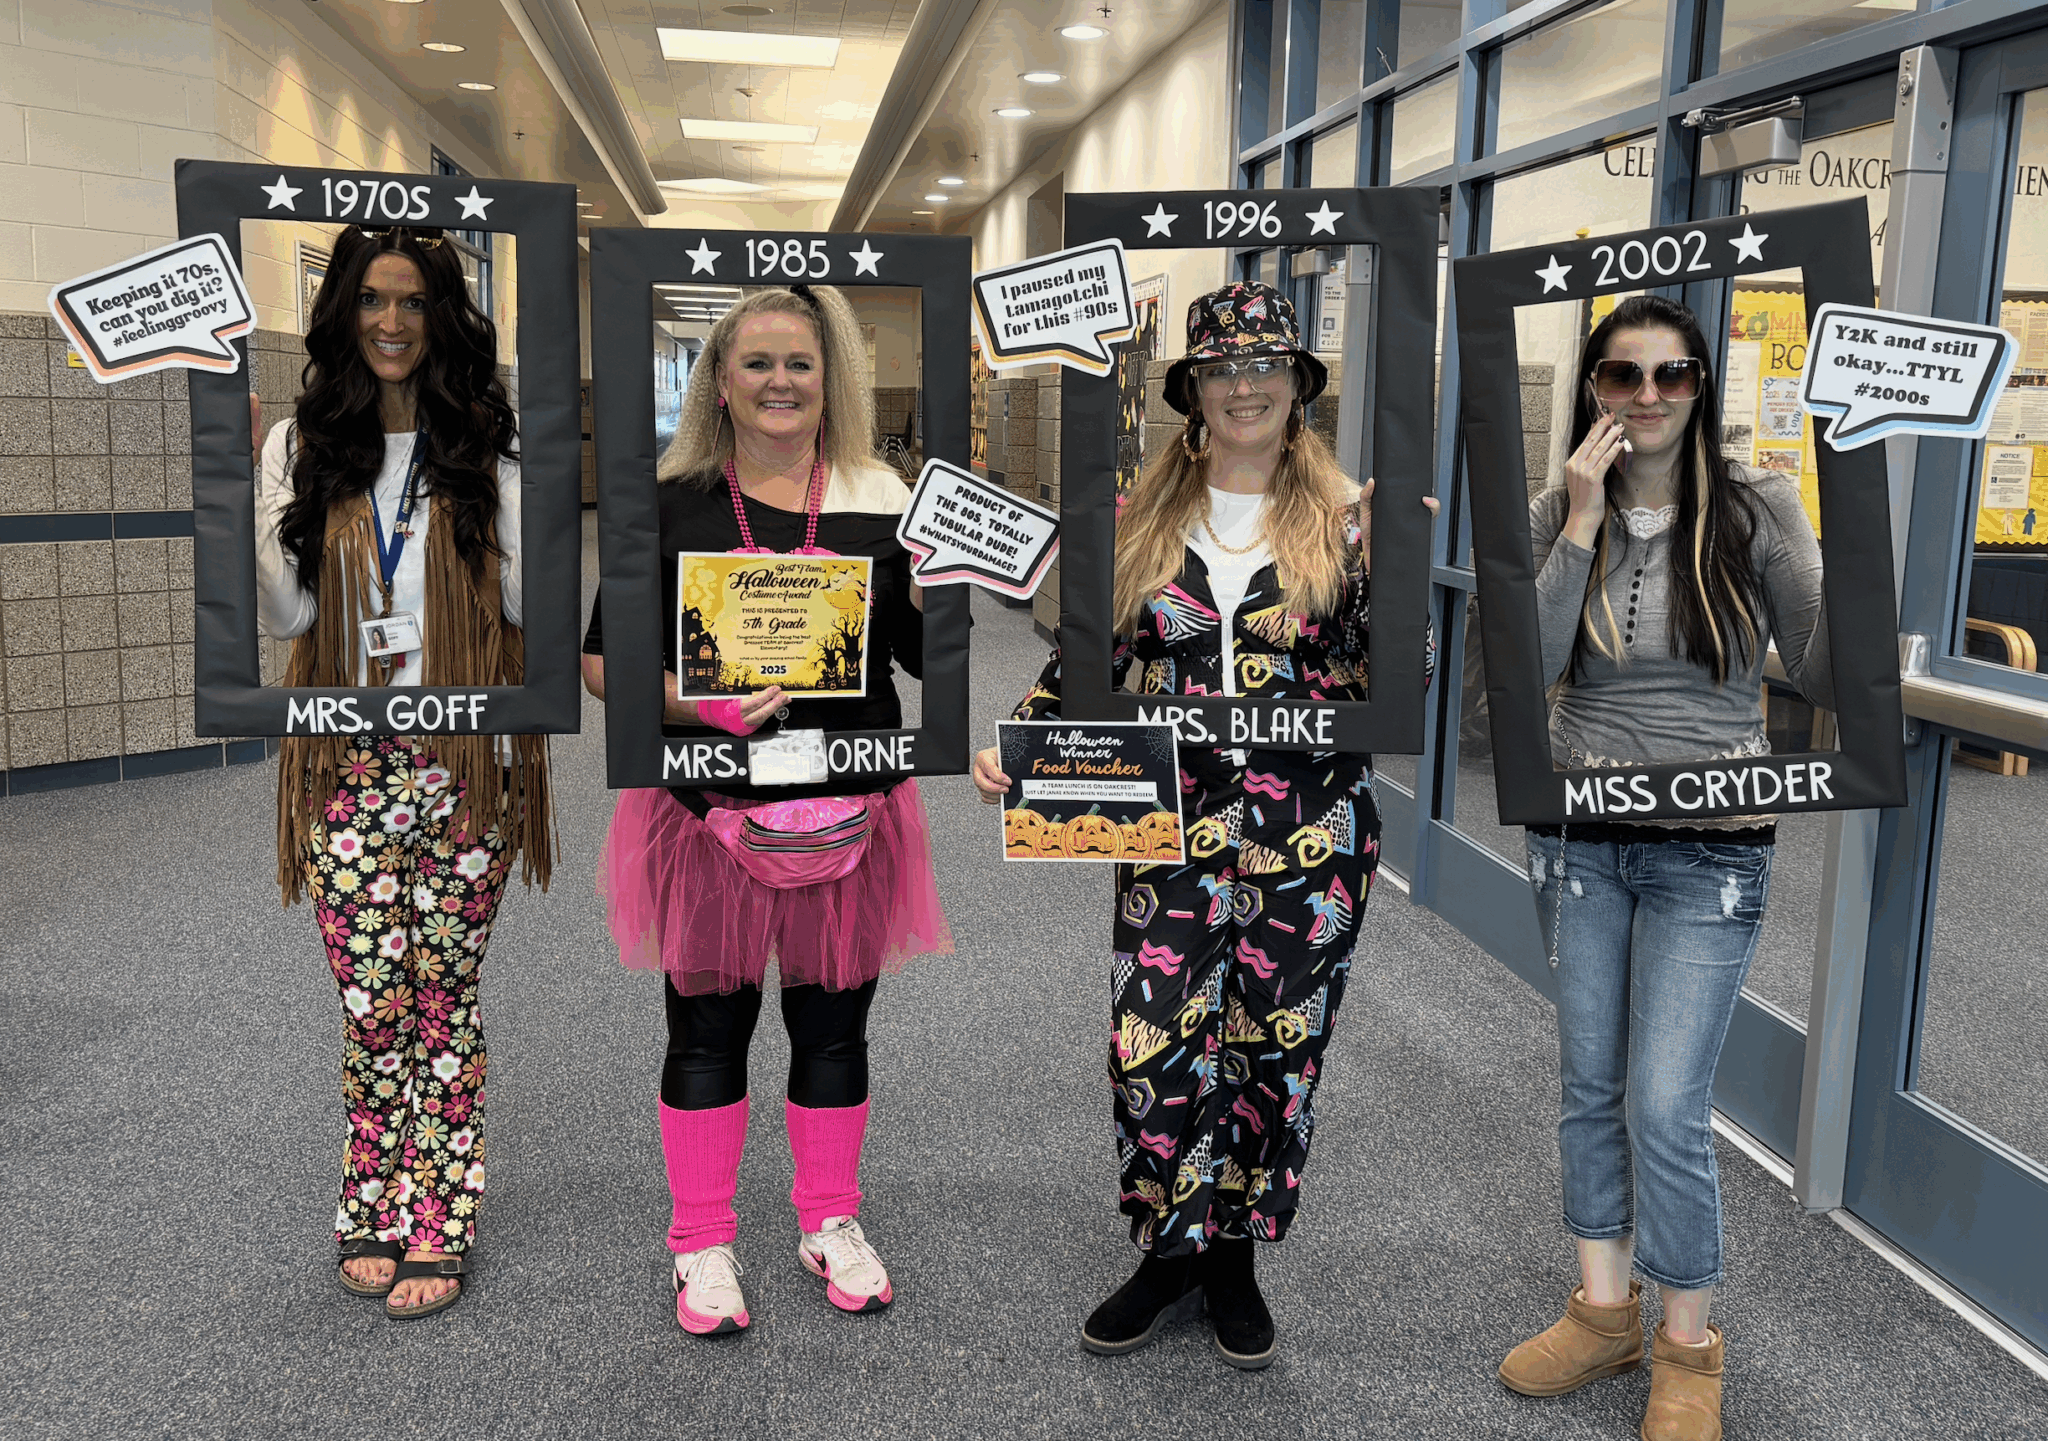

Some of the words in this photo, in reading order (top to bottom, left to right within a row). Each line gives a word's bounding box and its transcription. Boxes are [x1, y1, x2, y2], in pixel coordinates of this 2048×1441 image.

[321, 178, 431, 221] 1970S
[1203, 200, 1283, 240] 1996
[745, 238, 831, 279] 1985
[1591, 230, 1712, 288] 2002
[86, 281, 162, 316] Keeping
[160, 273, 177, 290] it
[176, 263, 219, 284] 70s,
[1001, 286, 1008, 300] I
[1010, 269, 1075, 300] paused
[1078, 265, 1106, 281] my
[1005, 280, 1109, 318] tamagotchi
[99, 313, 134, 333] can
[135, 301, 169, 325] you
[170, 289, 200, 308] dig
[198, 276, 223, 297] it?
[113, 298, 228, 348] #feelinggroovy
[1004, 322, 1031, 338] for
[1034, 312, 1070, 331] this
[1074, 301, 1118, 322] #90s
[1835, 324, 1878, 344] Y2K
[1883, 336, 1926, 351] and
[1931, 341, 1978, 358] still
[1833, 354, 1964, 384] okay...TTYL
[1854, 382, 1930, 406] #2000s
[936, 494, 958, 512] THE
[960, 507, 982, 526] 80S,
[988, 518, 1034, 545] TOTALLY
[955, 485, 1006, 514] PRODUCT
[1008, 510, 1024, 523] OF
[919, 524, 1018, 574] #WHATSYOURDAMAGE?
[933, 512, 984, 542] TUBULAR
[986, 537, 1018, 559] DUDE!
[728, 569, 821, 590] Halloween
[775, 564, 796, 576] Best
[740, 590, 776, 601] Costume
[777, 590, 812, 602] Award
[742, 616, 764, 629] 5th
[768, 617, 808, 635] Grade
[760, 665, 786, 674] 2025
[286, 696, 374, 734] MRS.
[386, 694, 488, 732] GOFF
[1230, 707, 1336, 744] BLAKE
[1046, 730, 1124, 747] Halloween
[1060, 746, 1113, 759] Winner
[662, 744, 748, 780] MRS.
[1032, 758, 1072, 775] Food
[1075, 757, 1144, 776] Voucher
[1565, 775, 1657, 816] MISS
[1670, 762, 1834, 810] CRYDER
